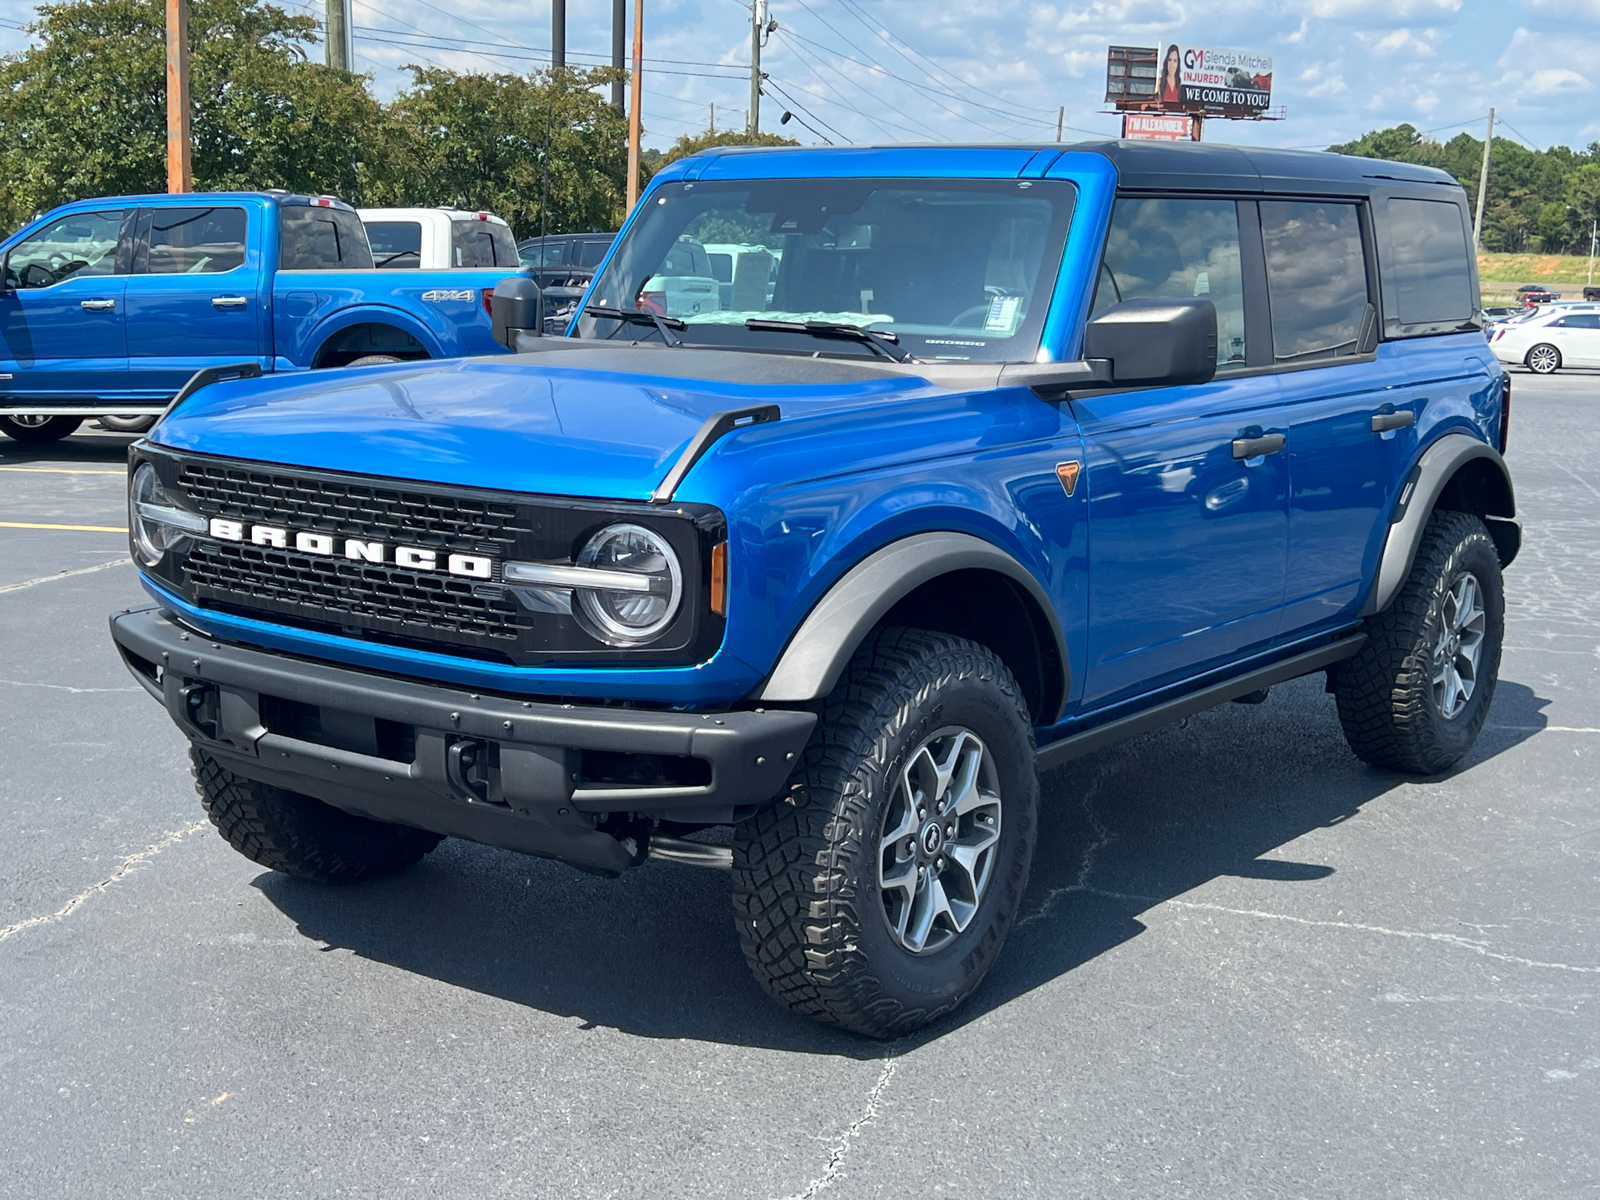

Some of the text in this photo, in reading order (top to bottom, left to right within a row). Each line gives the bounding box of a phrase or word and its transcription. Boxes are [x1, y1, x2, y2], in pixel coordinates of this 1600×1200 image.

[1204, 50, 1273, 69] Glenda Mitchell
[1183, 71, 1224, 84] INJURED?
[1185, 87, 1269, 107] WE COME TO YOU!
[210, 518, 492, 579] BRONCO
